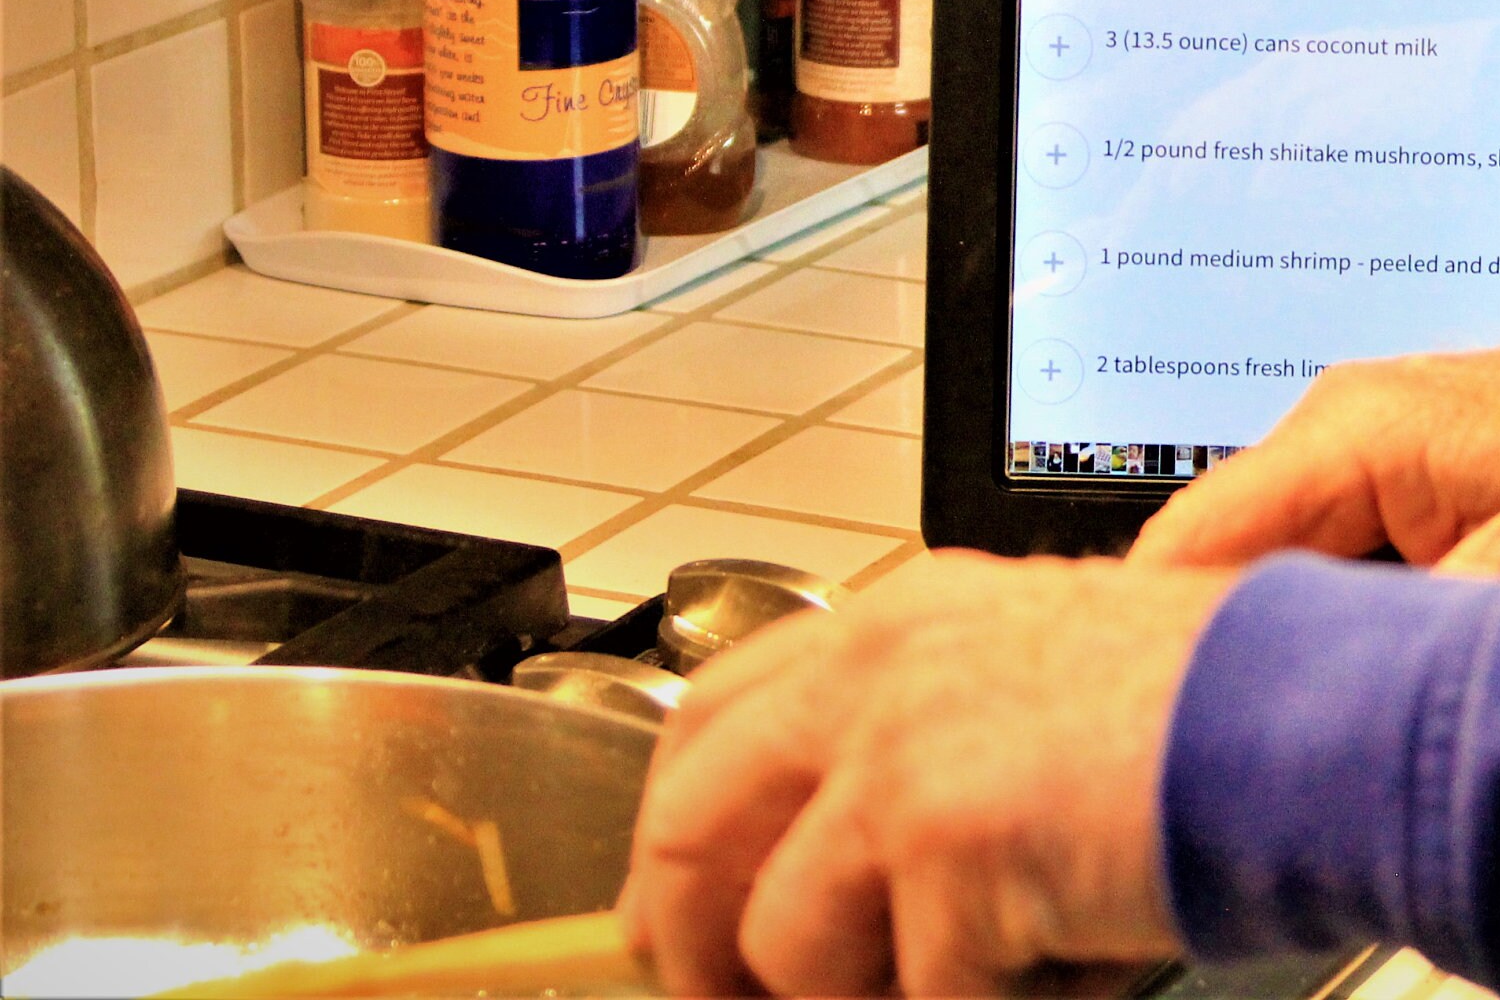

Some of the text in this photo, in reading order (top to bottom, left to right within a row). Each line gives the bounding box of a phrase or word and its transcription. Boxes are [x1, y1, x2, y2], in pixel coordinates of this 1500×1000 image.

[1106, 30, 1437, 56] 3 (13.5 ounce) cans coconut milk
[520, 82, 588, 121] Fine
[1104, 139, 1134, 160] 1/2
[1142, 141, 1206, 162] pound
[1215, 141, 1263, 160] fresh
[1270, 143, 1348, 163] shiitake
[1355, 146, 1481, 169] mushrooms,
[1101, 248, 1110, 264] 1
[1118, 248, 1182, 269] pound
[1191, 249, 1273, 268] medium
[1280, 251, 1350, 275] shrimp
[1370, 254, 1438, 276] peeled
[1445, 256, 1481, 274] and
[1097, 356, 1107, 372] 2
[1114, 355, 1239, 379] tablespoons
[1246, 358, 1294, 376] fresh
